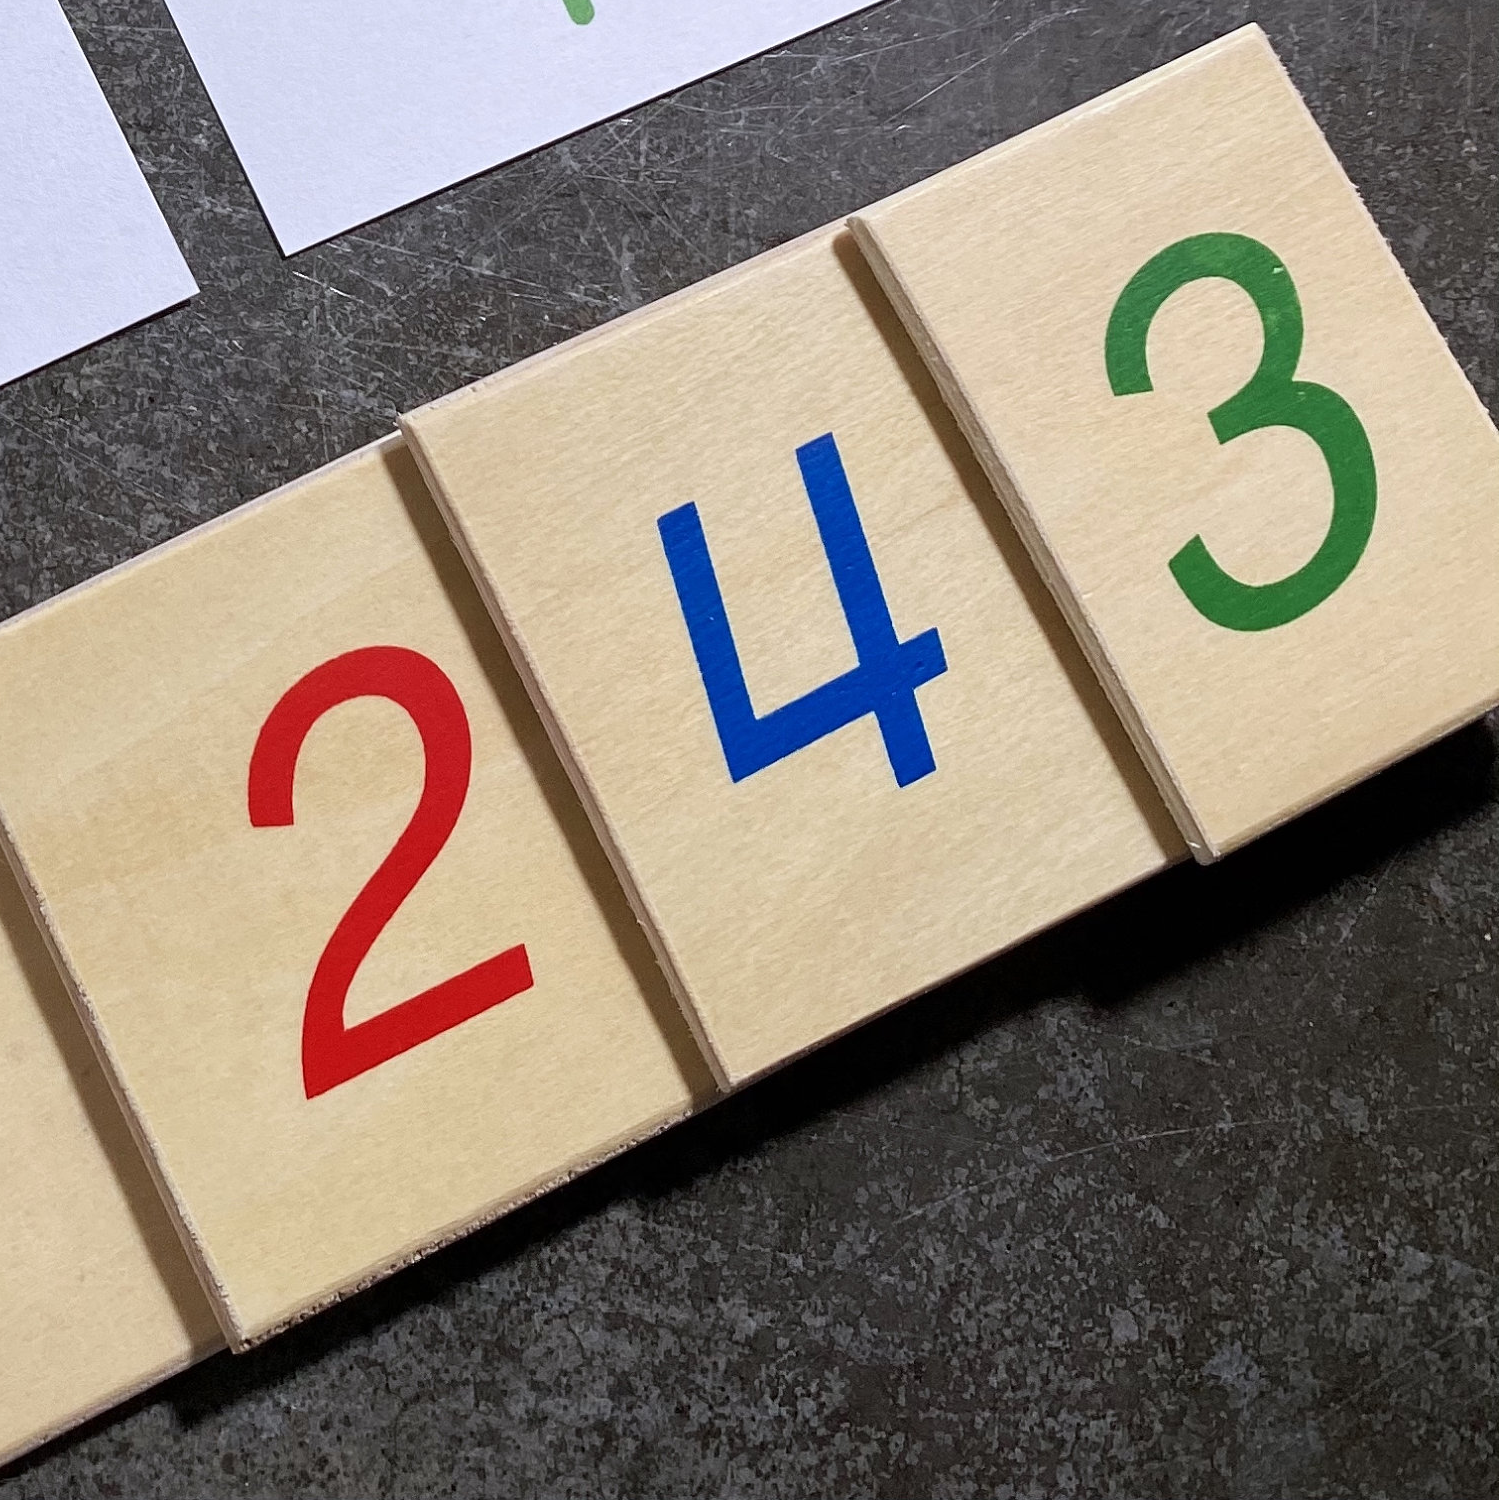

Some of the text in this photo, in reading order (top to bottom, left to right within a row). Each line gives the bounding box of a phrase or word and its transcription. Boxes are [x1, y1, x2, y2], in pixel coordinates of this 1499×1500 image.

[247, 645, 535, 1101] 2
[657, 433, 947, 788] 4
[1104, 232, 1378, 633] 3
